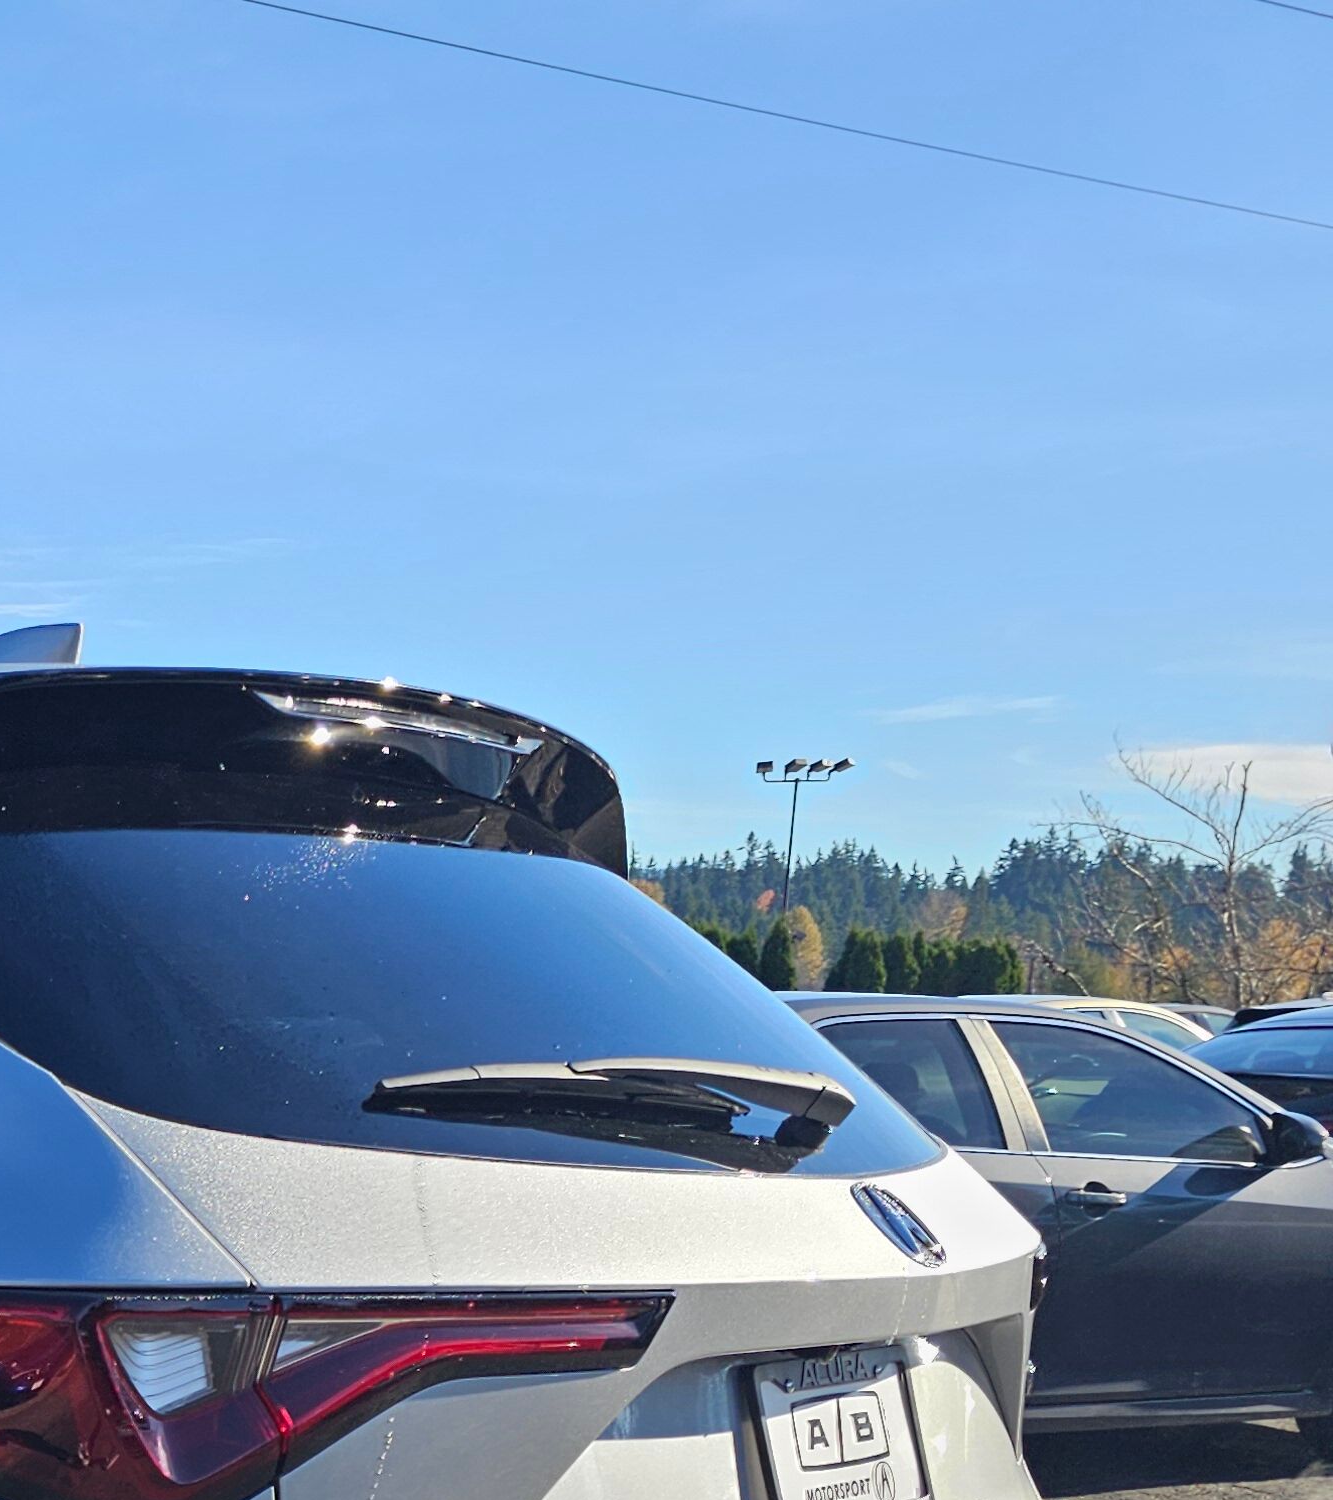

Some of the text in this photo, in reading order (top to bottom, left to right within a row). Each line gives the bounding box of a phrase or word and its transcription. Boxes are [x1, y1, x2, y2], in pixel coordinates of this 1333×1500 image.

[800, 1353, 869, 1388] ACURA
[808, 1411, 875, 1450] A B
